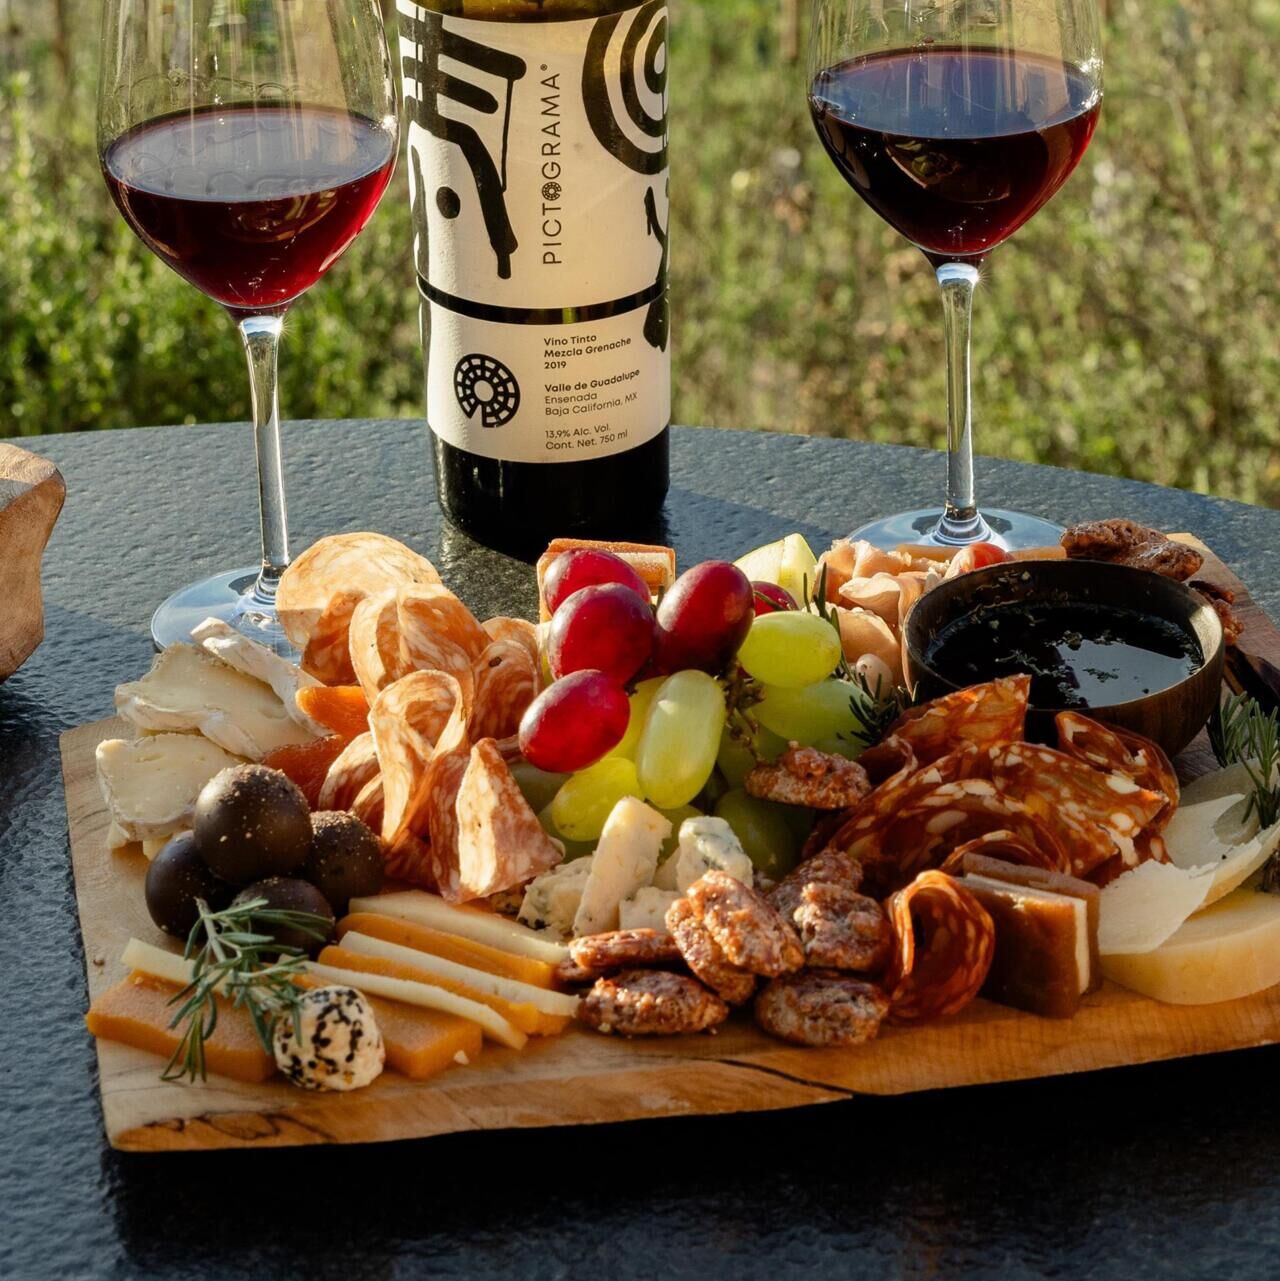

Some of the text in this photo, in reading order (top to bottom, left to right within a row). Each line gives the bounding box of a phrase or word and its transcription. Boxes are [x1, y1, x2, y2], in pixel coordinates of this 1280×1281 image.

[544, 334, 597, 346] Vino Tinto
[544, 337, 631, 358] Mezcla Grenache
[544, 361, 567, 369] 2019
[545, 369, 640, 392] Valle de Guadalupe
[545, 392, 597, 404] Ensenada
[545, 392, 637, 416] Baja California, MX
[546, 430, 627, 450] Cont. Net. 750 ml
[573, 427, 591, 437] Alc.
